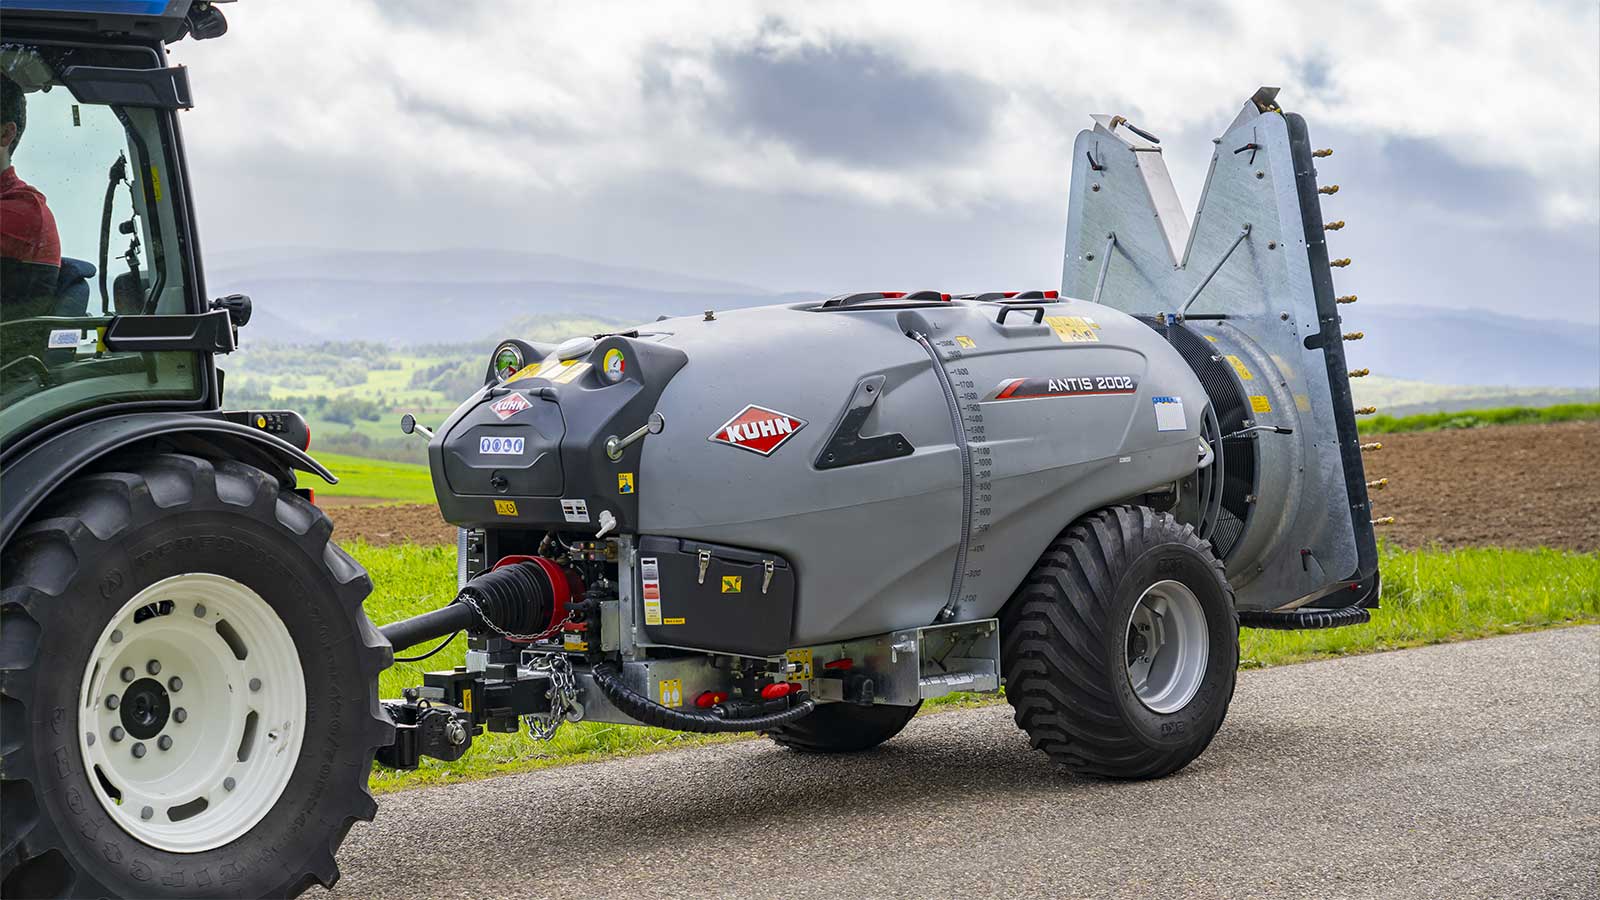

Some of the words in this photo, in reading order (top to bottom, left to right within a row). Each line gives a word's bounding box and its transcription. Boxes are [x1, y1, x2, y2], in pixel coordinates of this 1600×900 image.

[1047, 377, 1094, 392] ANTIS
[1095, 376, 1134, 390] 2002
[494, 400, 526, 411] KUHN
[725, 416, 793, 443] KUHN
